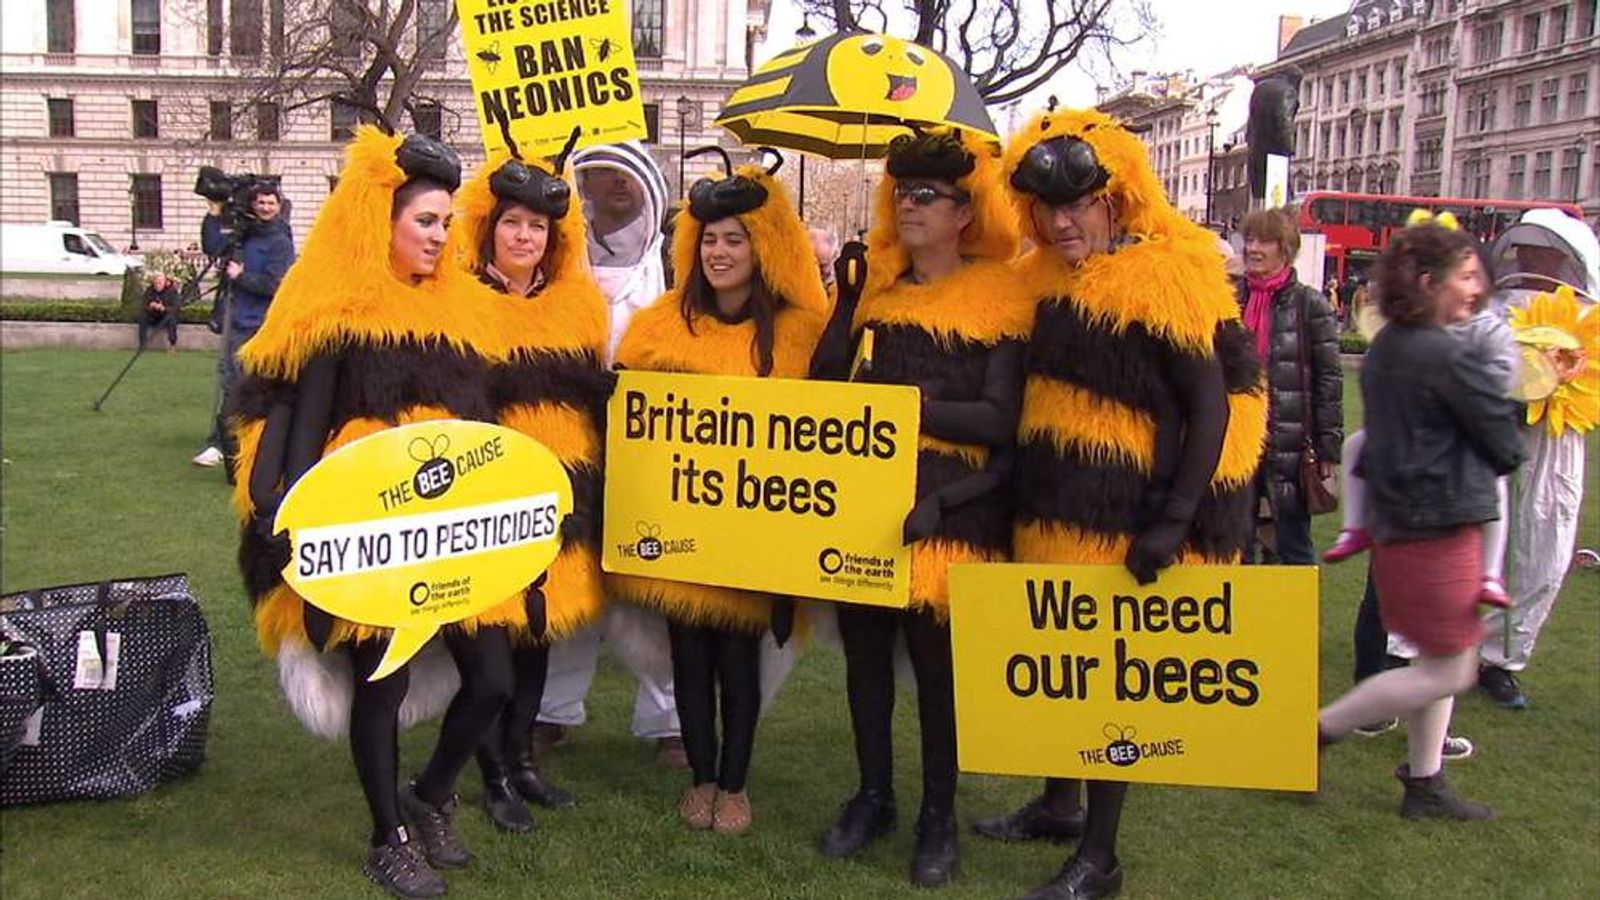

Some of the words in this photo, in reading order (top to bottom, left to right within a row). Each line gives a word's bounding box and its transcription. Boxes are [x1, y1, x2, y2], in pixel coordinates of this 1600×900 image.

[474, 10, 515, 35] THE
[520, 0, 610, 28] SCIENCE
[514, 35, 586, 79] BAN
[481, 67, 633, 124] NEONICS
[625, 390, 754, 448] Britain
[767, 405, 897, 460] needs
[378, 481, 413, 511] THE
[417, 465, 452, 495] BEE
[456, 436, 504, 476] CAUSE
[671, 453, 724, 507] its
[736, 459, 837, 518] bees
[299, 536, 351, 577] SAY
[358, 532, 393, 569] NO
[400, 527, 428, 562] TO
[436, 504, 557, 556] PESTICIDES
[617, 544, 637, 558] THE
[640, 542, 660, 557] BEE
[663, 538, 697, 554] CAUSE
[845, 552, 881, 567] friends
[883, 558, 895, 568] of
[448, 586, 471, 598] earth
[844, 564, 862, 575] the
[864, 568, 894, 579] earth
[1026, 579, 1098, 631] We
[1113, 582, 1232, 635] need
[1006, 653, 1100, 700] our
[1114, 637, 1260, 707] bees
[1079, 748, 1106, 766] THE
[1109, 745, 1137, 762] BEE
[1140, 739, 1185, 759] CAUSE
